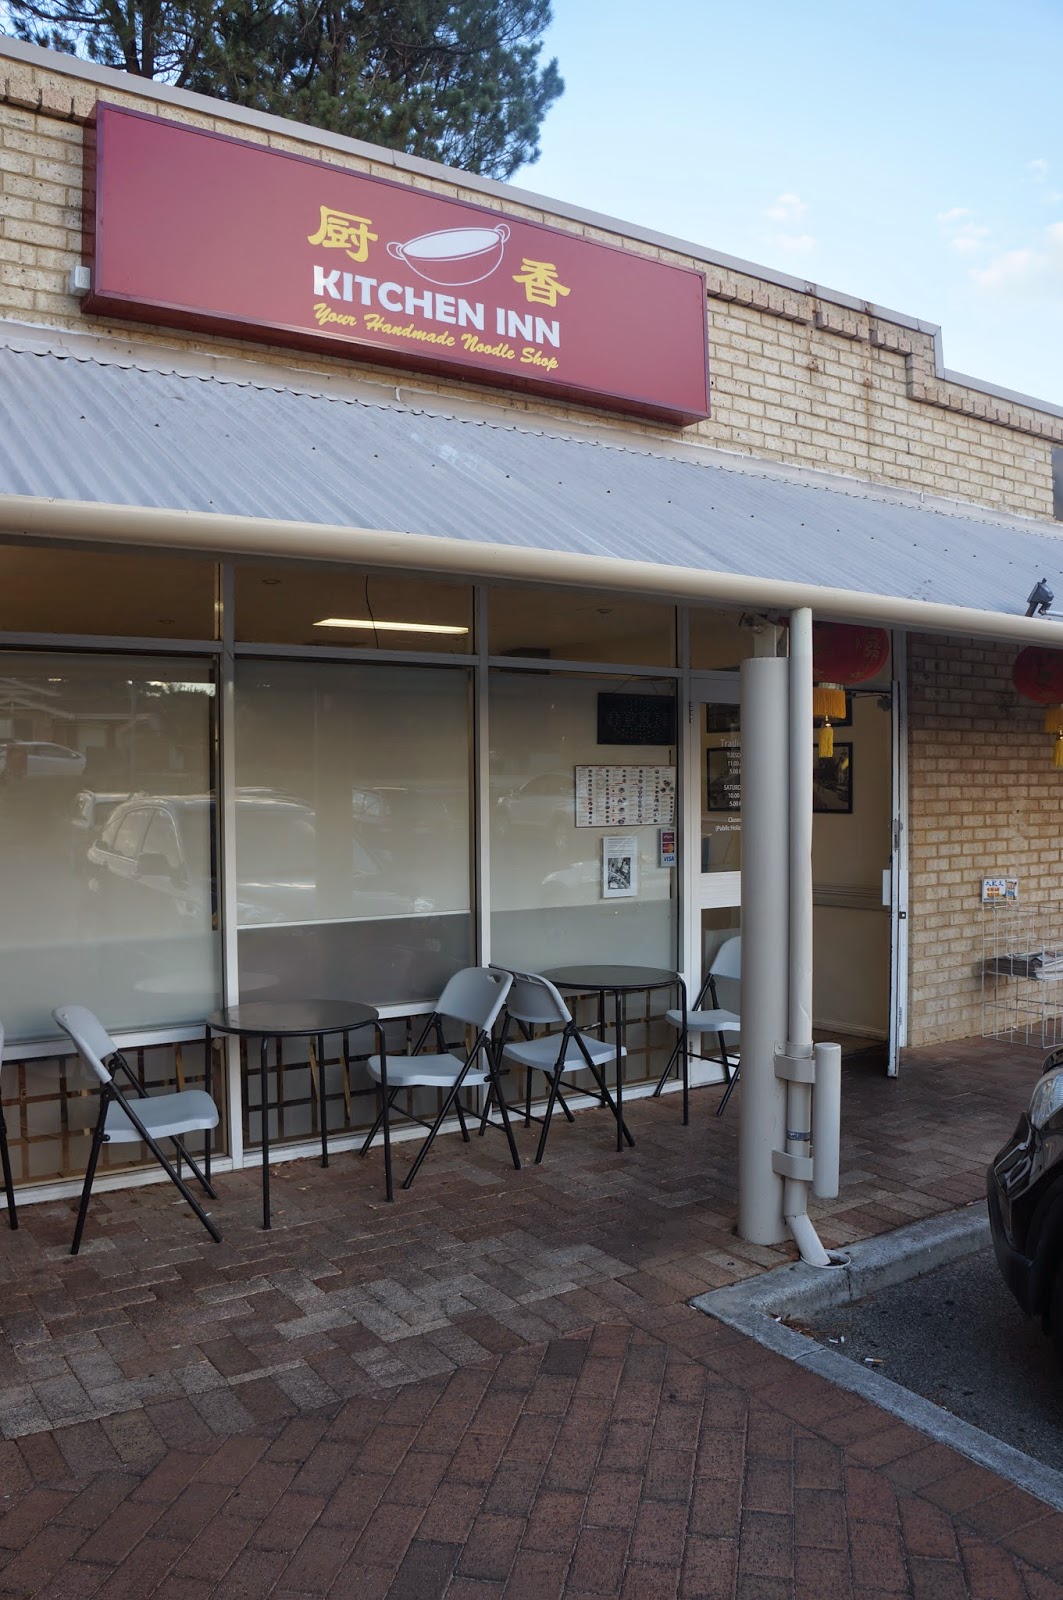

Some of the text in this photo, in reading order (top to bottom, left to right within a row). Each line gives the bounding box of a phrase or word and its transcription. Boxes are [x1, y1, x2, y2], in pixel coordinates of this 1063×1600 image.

[307, 205, 379, 263] 厨
[313, 265, 560, 348] KITCHEN INN
[512, 257, 571, 308] 香
[313, 303, 559, 371] Your Handmade Noodle Shop
[720, 738, 741, 748] Tradi
